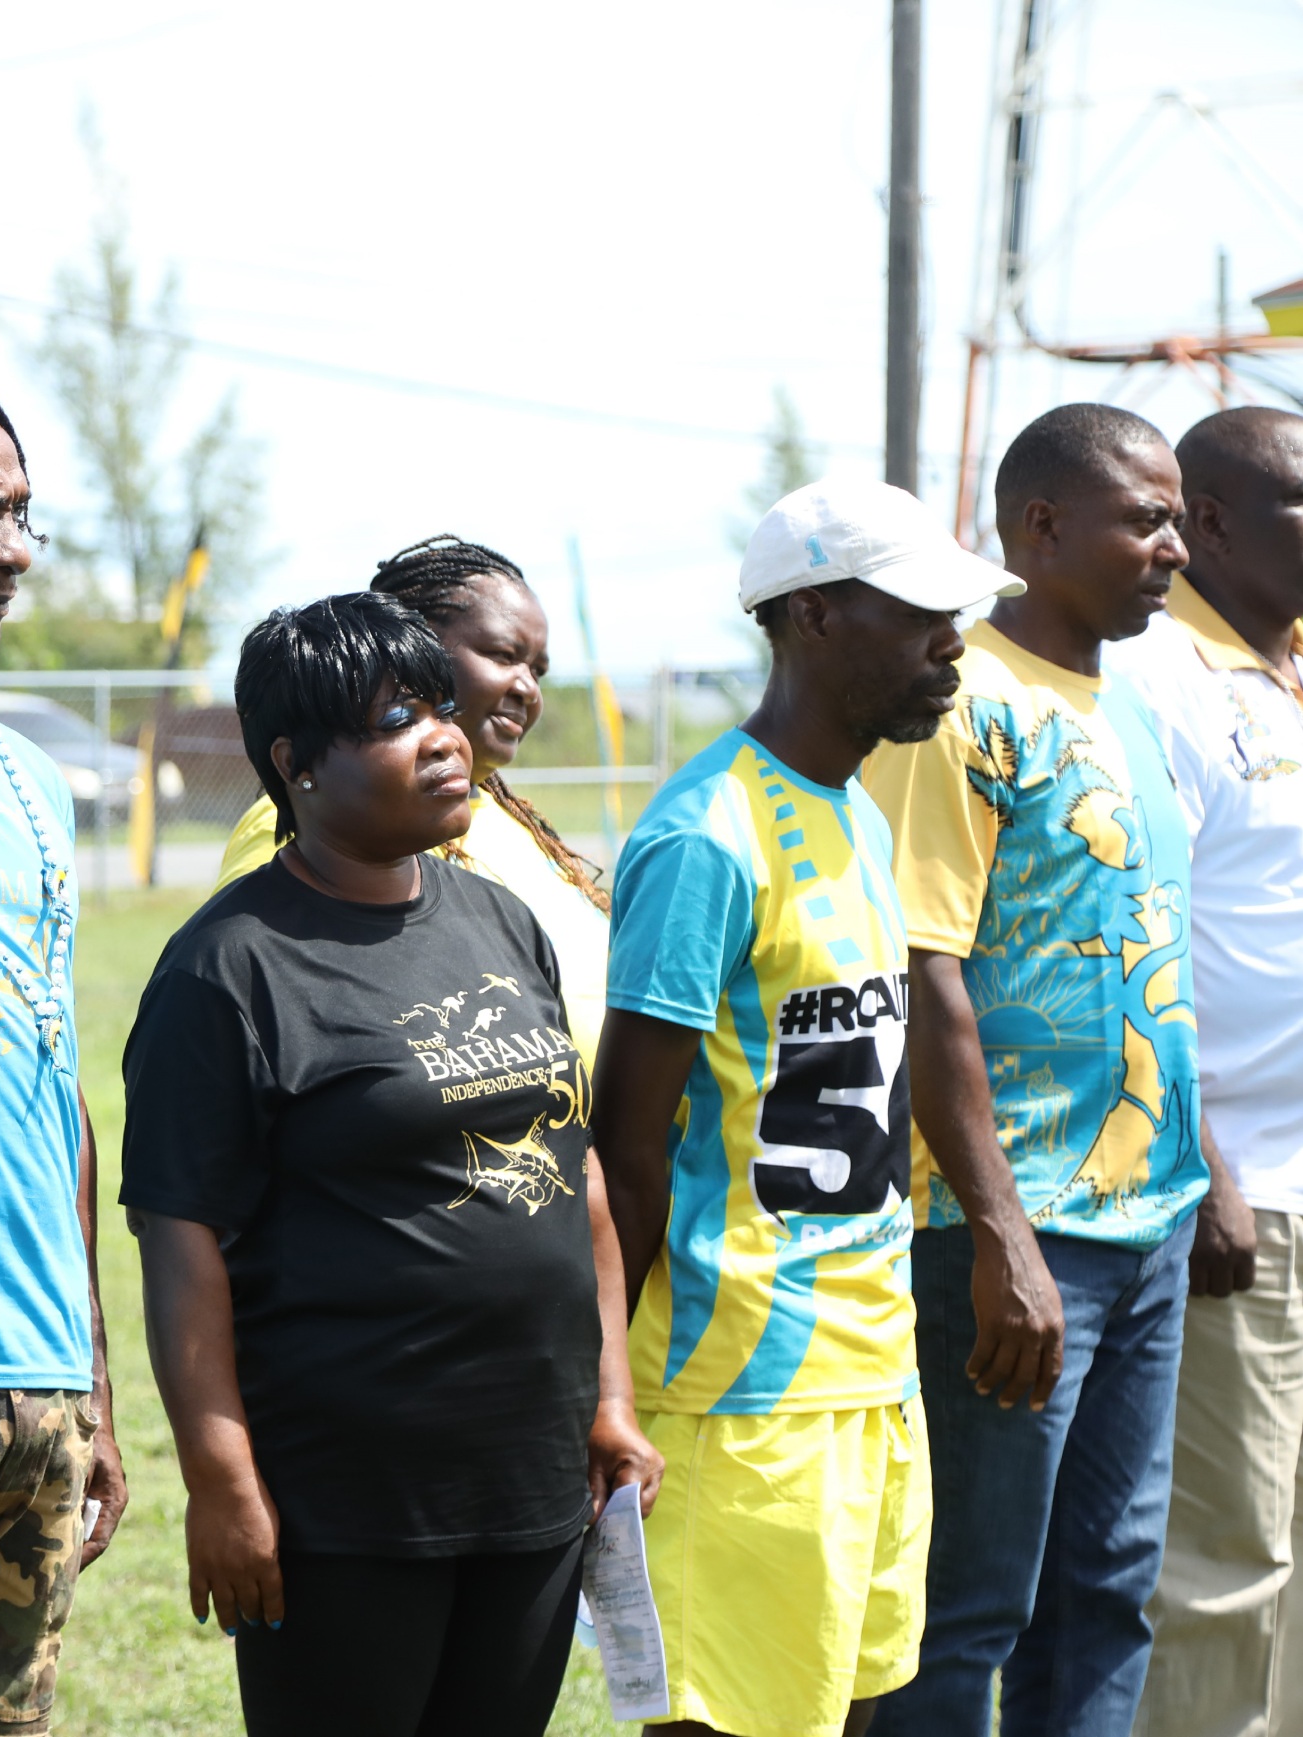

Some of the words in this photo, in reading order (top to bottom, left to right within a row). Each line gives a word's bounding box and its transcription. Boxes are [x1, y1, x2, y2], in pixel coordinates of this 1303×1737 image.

[805, 534, 828, 567] 1
[408, 1031, 446, 1051] THE
[414, 1027, 579, 1082] BAHAMA
[441, 1067, 548, 1104] INDEPENDENCE
[548, 1058, 593, 1130] 50
